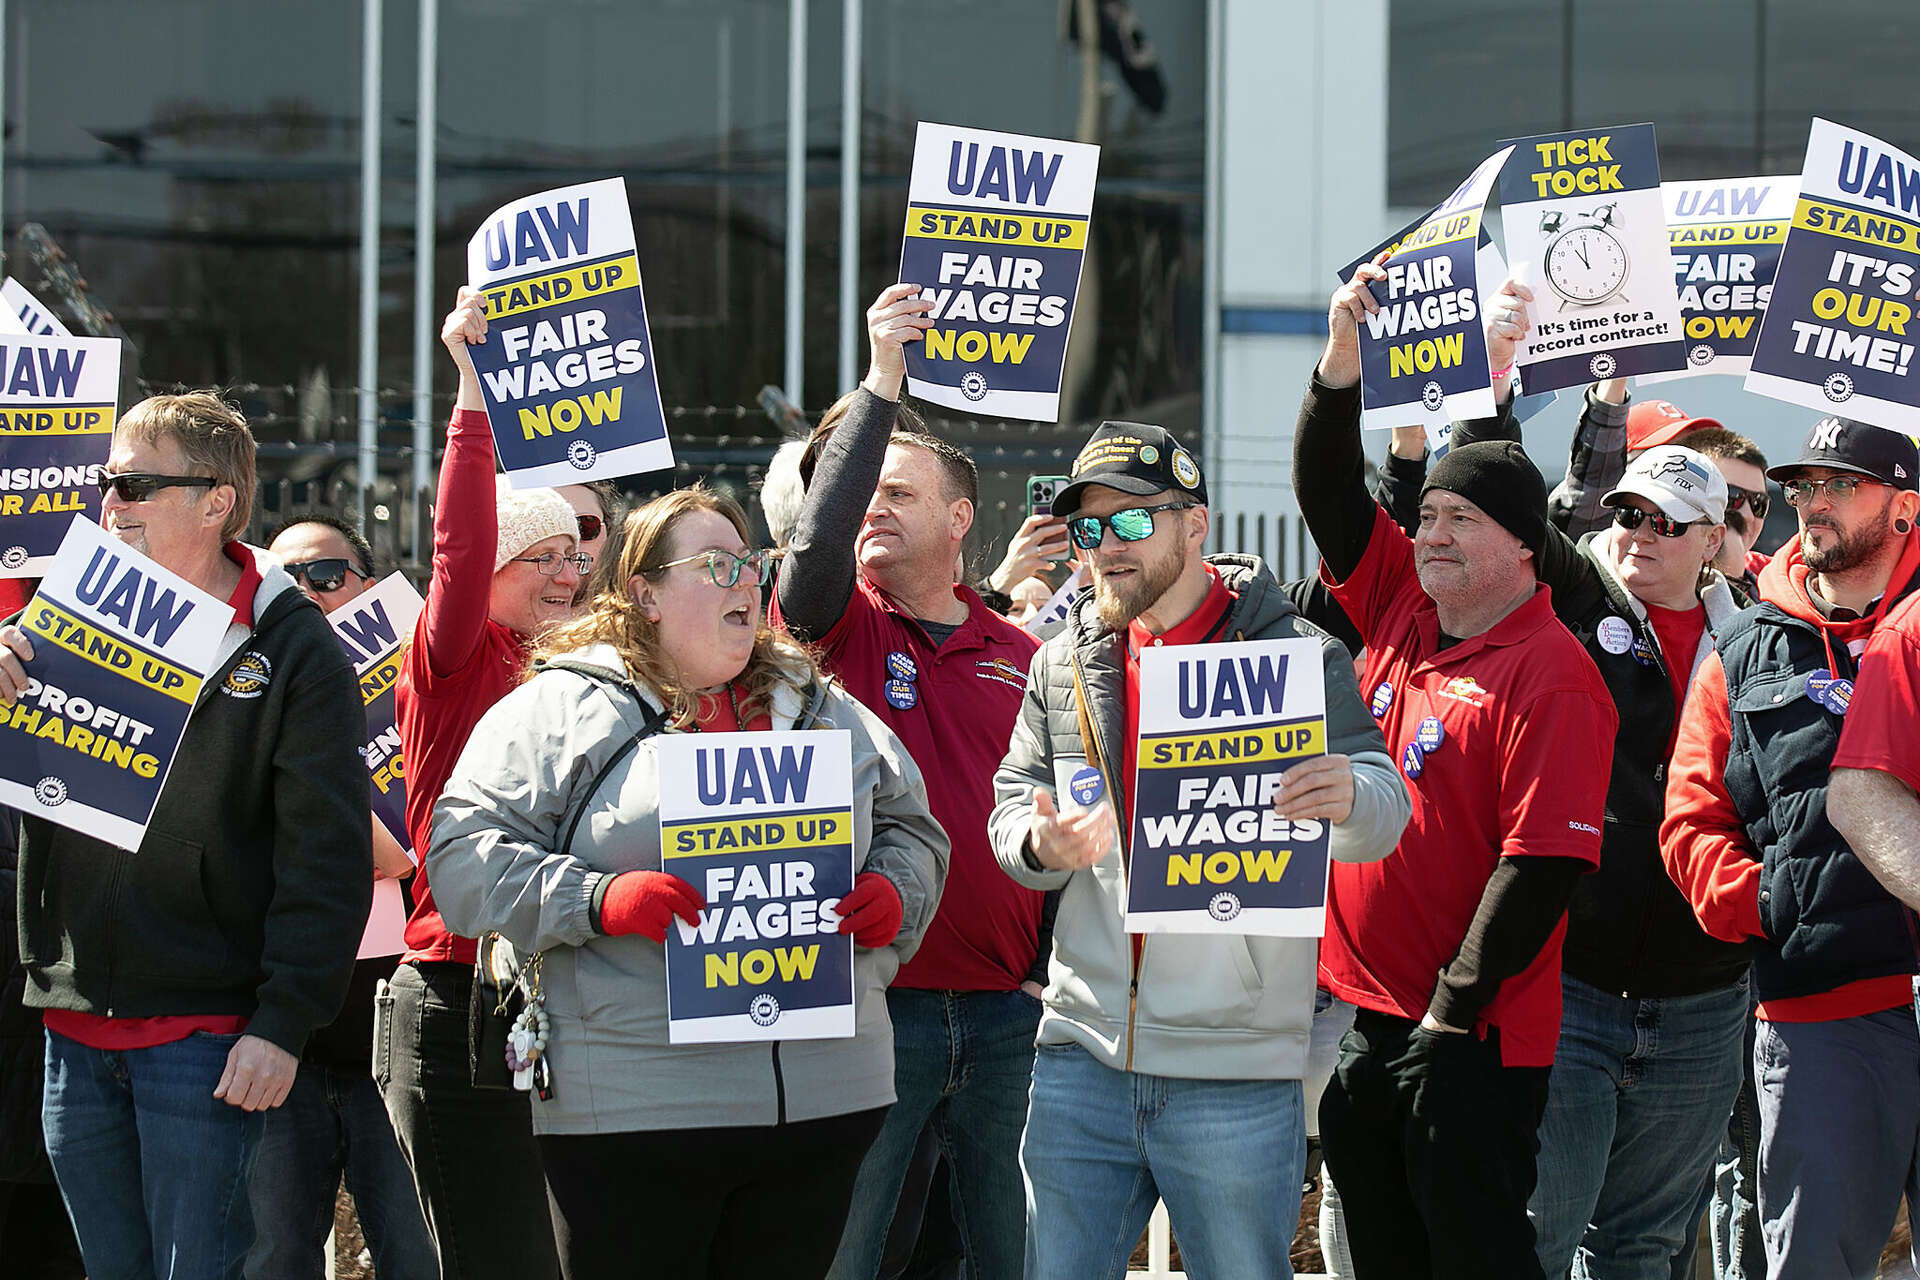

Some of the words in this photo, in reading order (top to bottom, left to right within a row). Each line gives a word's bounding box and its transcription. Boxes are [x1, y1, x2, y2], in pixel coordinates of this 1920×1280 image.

[1536, 136, 1613, 168] TICK
[948, 140, 1064, 207] UAW
[1531, 164, 1624, 198] TOCK
[1675, 186, 1771, 217] UAW
[485, 197, 590, 272] UAW
[920, 213, 1022, 240] STAND
[1032, 222, 1072, 243] UP
[1445, 215, 1471, 238] UP
[1668, 227, 1735, 243] TAND
[1744, 225, 1778, 240] UP
[1805, 206, 1906, 244] STAND
[582, 265, 623, 291] UP
[938, 251, 1044, 290] FAIR
[1387, 255, 1454, 300] FAIR
[1671, 254, 1756, 281] FAIR
[1827, 250, 1915, 295] IT'S
[907, 287, 1067, 327] WAGES
[1366, 287, 1477, 340] WAGES
[1679, 284, 1773, 311] AGES
[1812, 288, 1911, 336] OUR
[501, 309, 609, 363] FAIR
[1528, 334, 1585, 355] record
[1590, 322, 1669, 344] contract!
[1538, 322, 1565, 337] It's
[1569, 318, 1609, 332] time
[1613, 312, 1639, 325] for
[1643, 311, 1654, 321] a
[1682, 316, 1756, 339] OW
[925, 328, 1035, 365] NOW
[1389, 332, 1464, 379] NOW
[1791, 320, 1915, 377] TIME!
[483, 338, 646, 403] WAGES
[64, 412, 101, 431] UP
[518, 386, 623, 441] NOW
[29, 491, 87, 514] ALL
[1673, 477, 1694, 492] FOX
[75, 545, 196, 648] UAW
[34, 608, 134, 669] STAND
[141, 661, 185, 691] UP
[1178, 654, 1290, 719] UAW
[1153, 737, 1263, 763] STAND
[1274, 729, 1312, 752] UP
[696, 745, 815, 806] UAW
[676, 824, 785, 852] STAND
[796, 819, 837, 842] UP
[1142, 810, 1323, 849] WAGES
[706, 861, 816, 904] FAIR
[1166, 850, 1292, 886] NOW
[673, 898, 845, 947] WAGES
[704, 944, 820, 989] NOW
